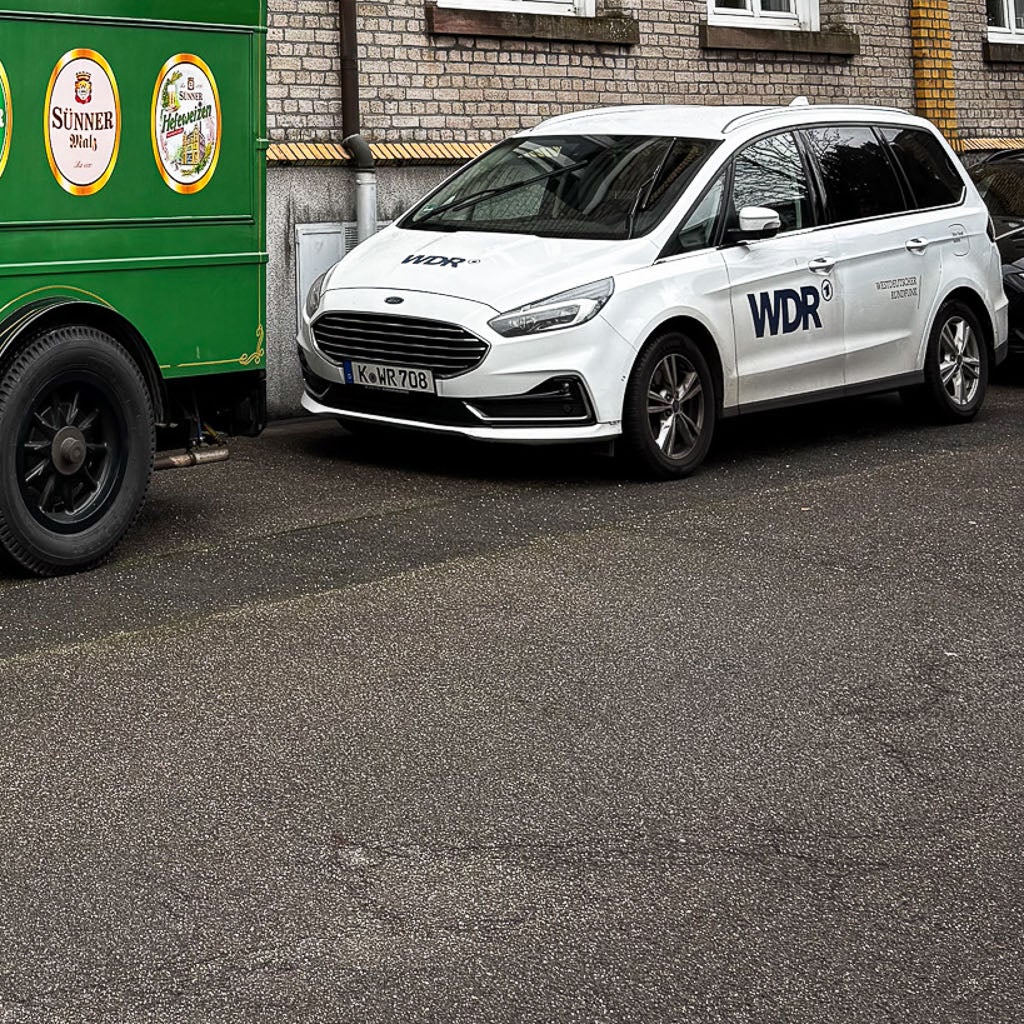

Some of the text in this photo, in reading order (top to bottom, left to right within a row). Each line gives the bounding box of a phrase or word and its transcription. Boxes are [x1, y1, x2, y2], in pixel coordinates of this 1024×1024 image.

[51, 106, 114, 131] SÜNNER
[161, 103, 212, 134] Hefeweizen
[68, 133, 98, 152] Malz
[401, 254, 466, 268] WDR
[747, 285, 823, 339] WDR
[358, 365, 369, 384] K
[376, 366, 398, 387] WR
[398, 369, 428, 390] 708
